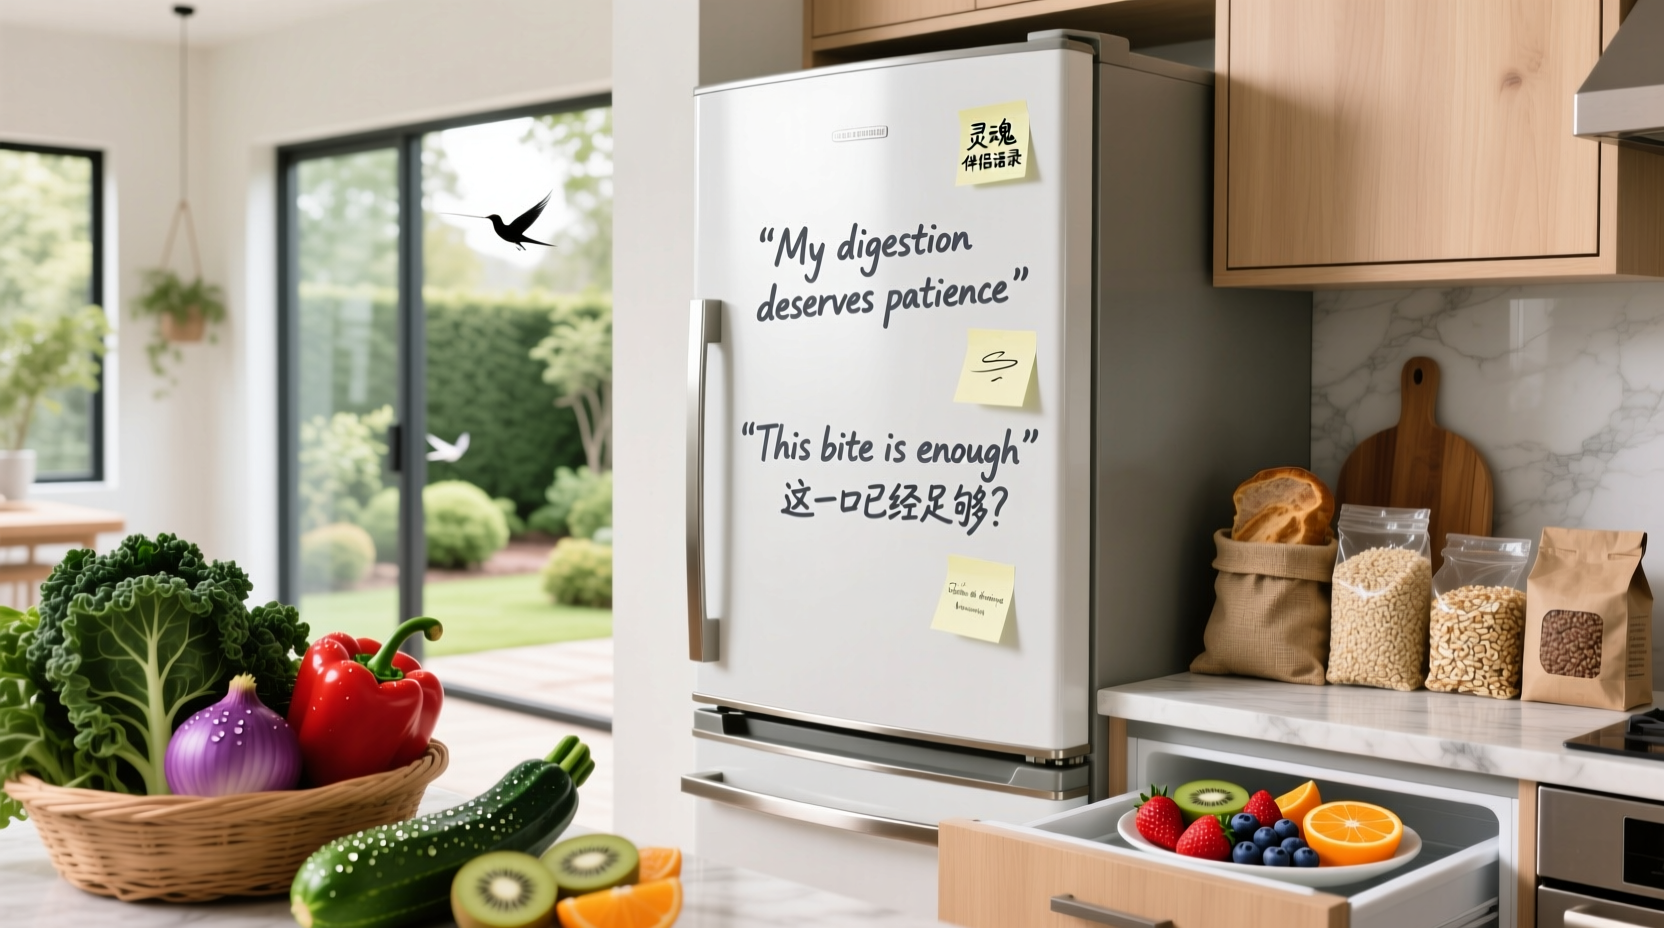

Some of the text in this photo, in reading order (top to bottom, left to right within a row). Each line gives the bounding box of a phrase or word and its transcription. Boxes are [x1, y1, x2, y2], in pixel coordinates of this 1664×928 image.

[966, 117, 1017, 151] 灵魂
[759, 222, 973, 284] “My digestion
[756, 266, 1029, 329] deserves patience”
[741, 421, 1039, 483] “This bite is enough”
